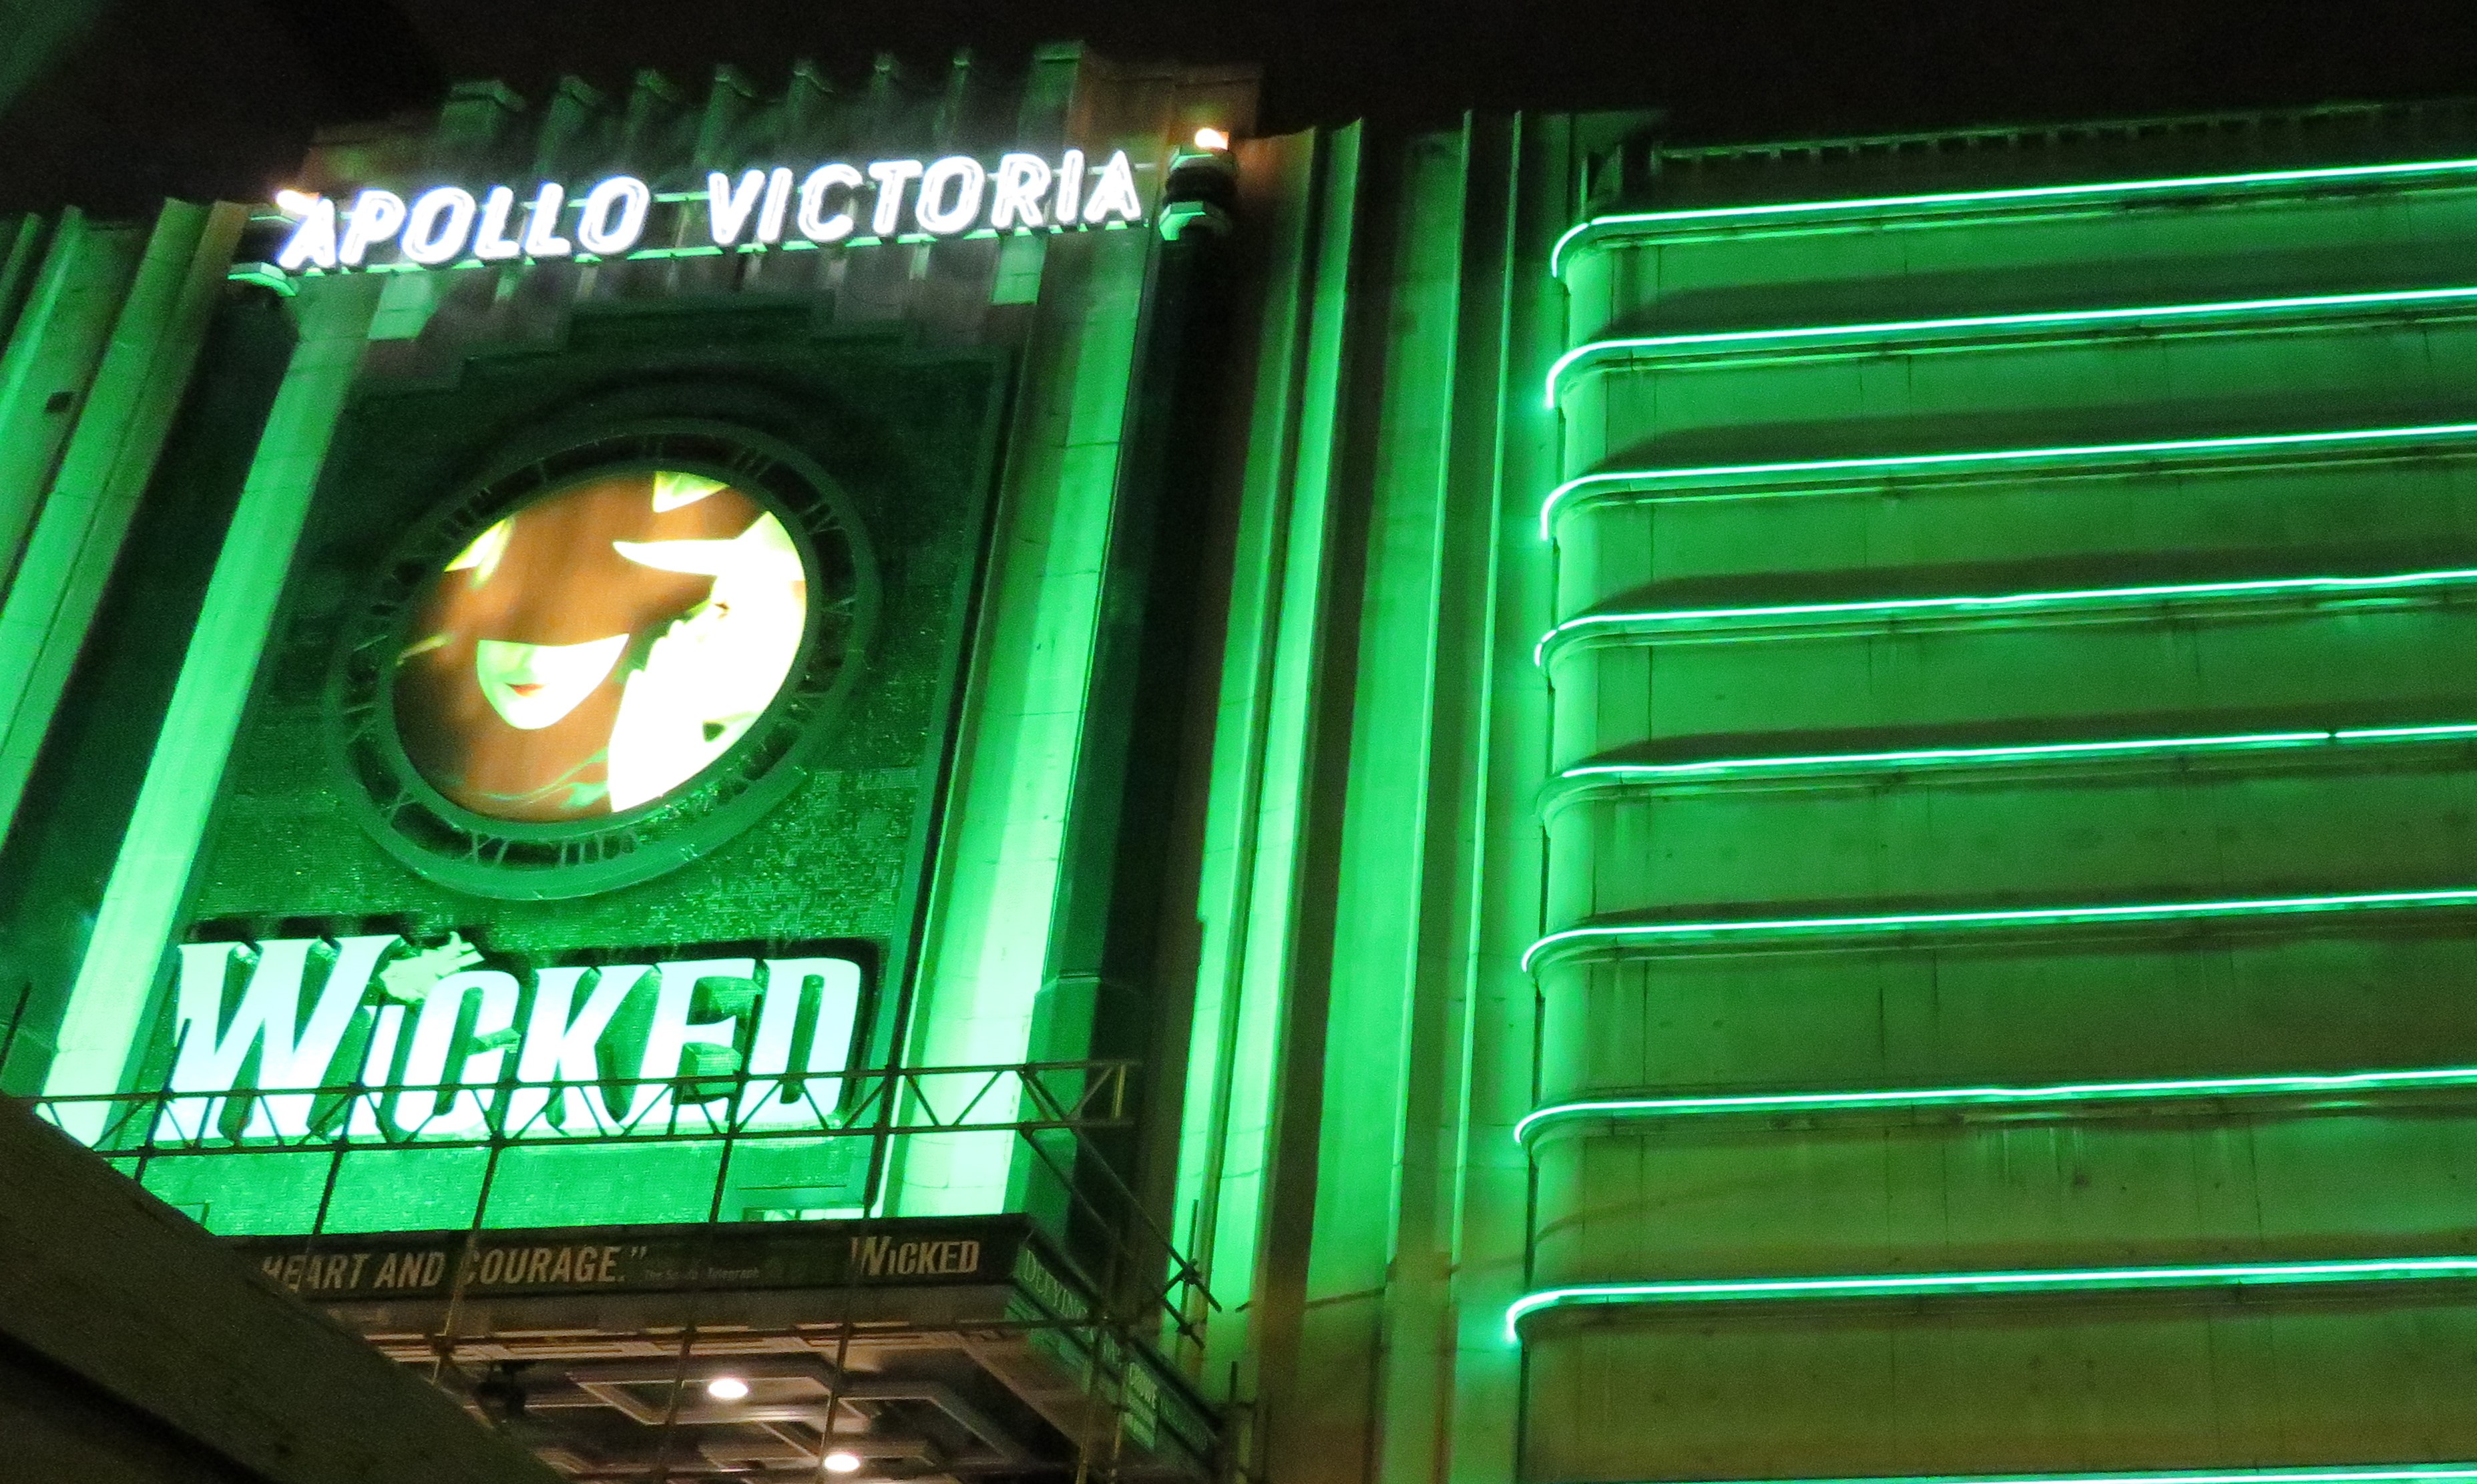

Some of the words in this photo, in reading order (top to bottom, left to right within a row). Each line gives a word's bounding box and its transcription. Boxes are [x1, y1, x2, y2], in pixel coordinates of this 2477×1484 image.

[275, 175, 649, 268] APOLLO
[708, 148, 1142, 244] VICTORIA
[373, 1252, 447, 1289] AND
